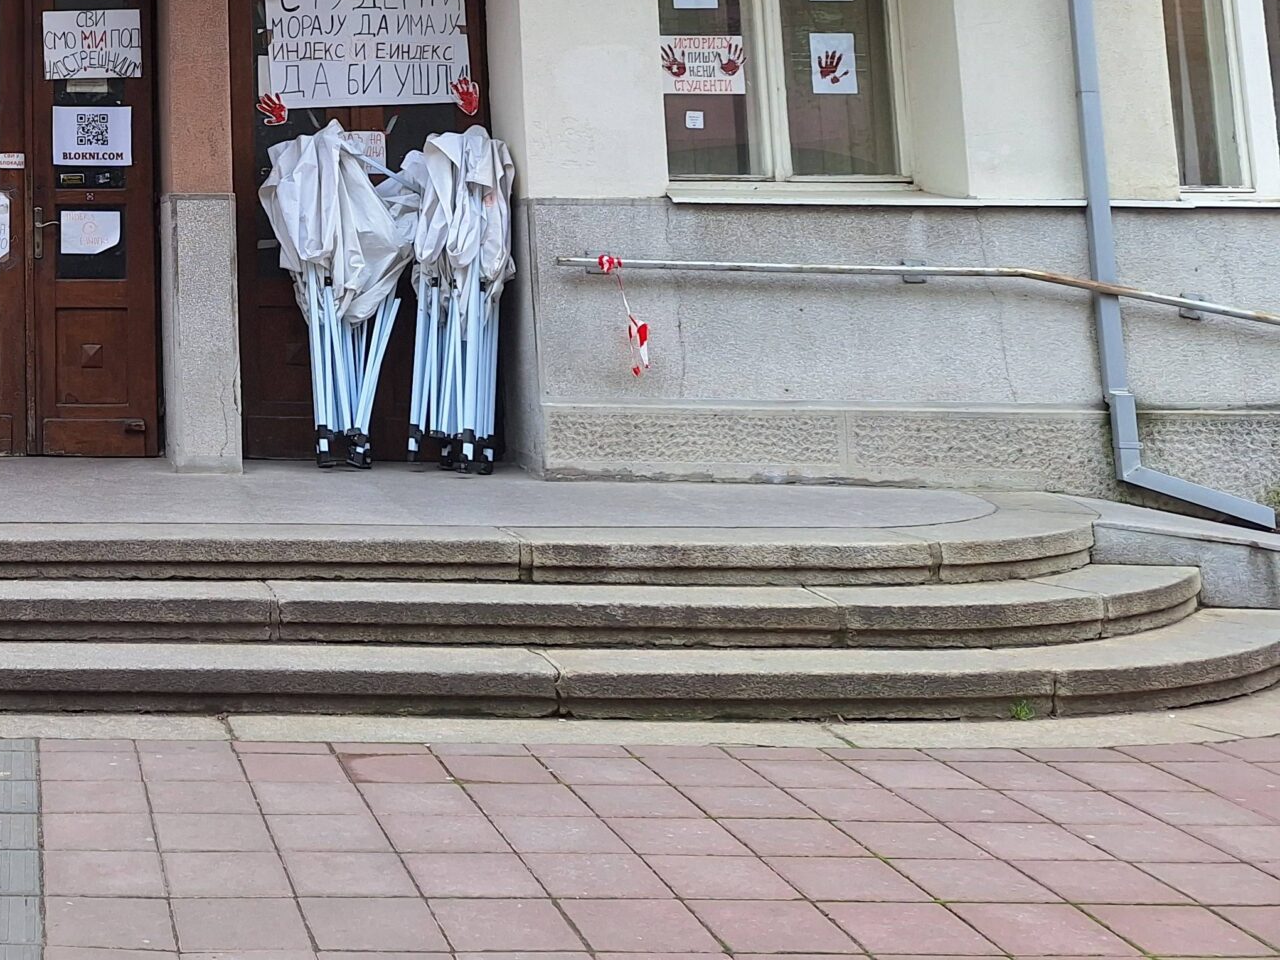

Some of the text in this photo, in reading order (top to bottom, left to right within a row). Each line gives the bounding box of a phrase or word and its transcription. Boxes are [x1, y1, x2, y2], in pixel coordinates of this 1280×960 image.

[76, 11, 105, 27] СВИ
[272, 13, 460, 38] МОРАЈУ ДА ИМАЈУ
[45, 28, 140, 50] СМО МИ ПОД
[273, 42, 345, 61] ИНДЕКС
[355, 43, 366, 60] И
[687, 52, 719, 64] ПИШУ
[280, 63, 331, 98] ДА
[348, 64, 382, 94] БИ
[674, 79, 733, 93] СТУДЕНТИ
[62, 152, 124, 160] BLOKNI.COM
